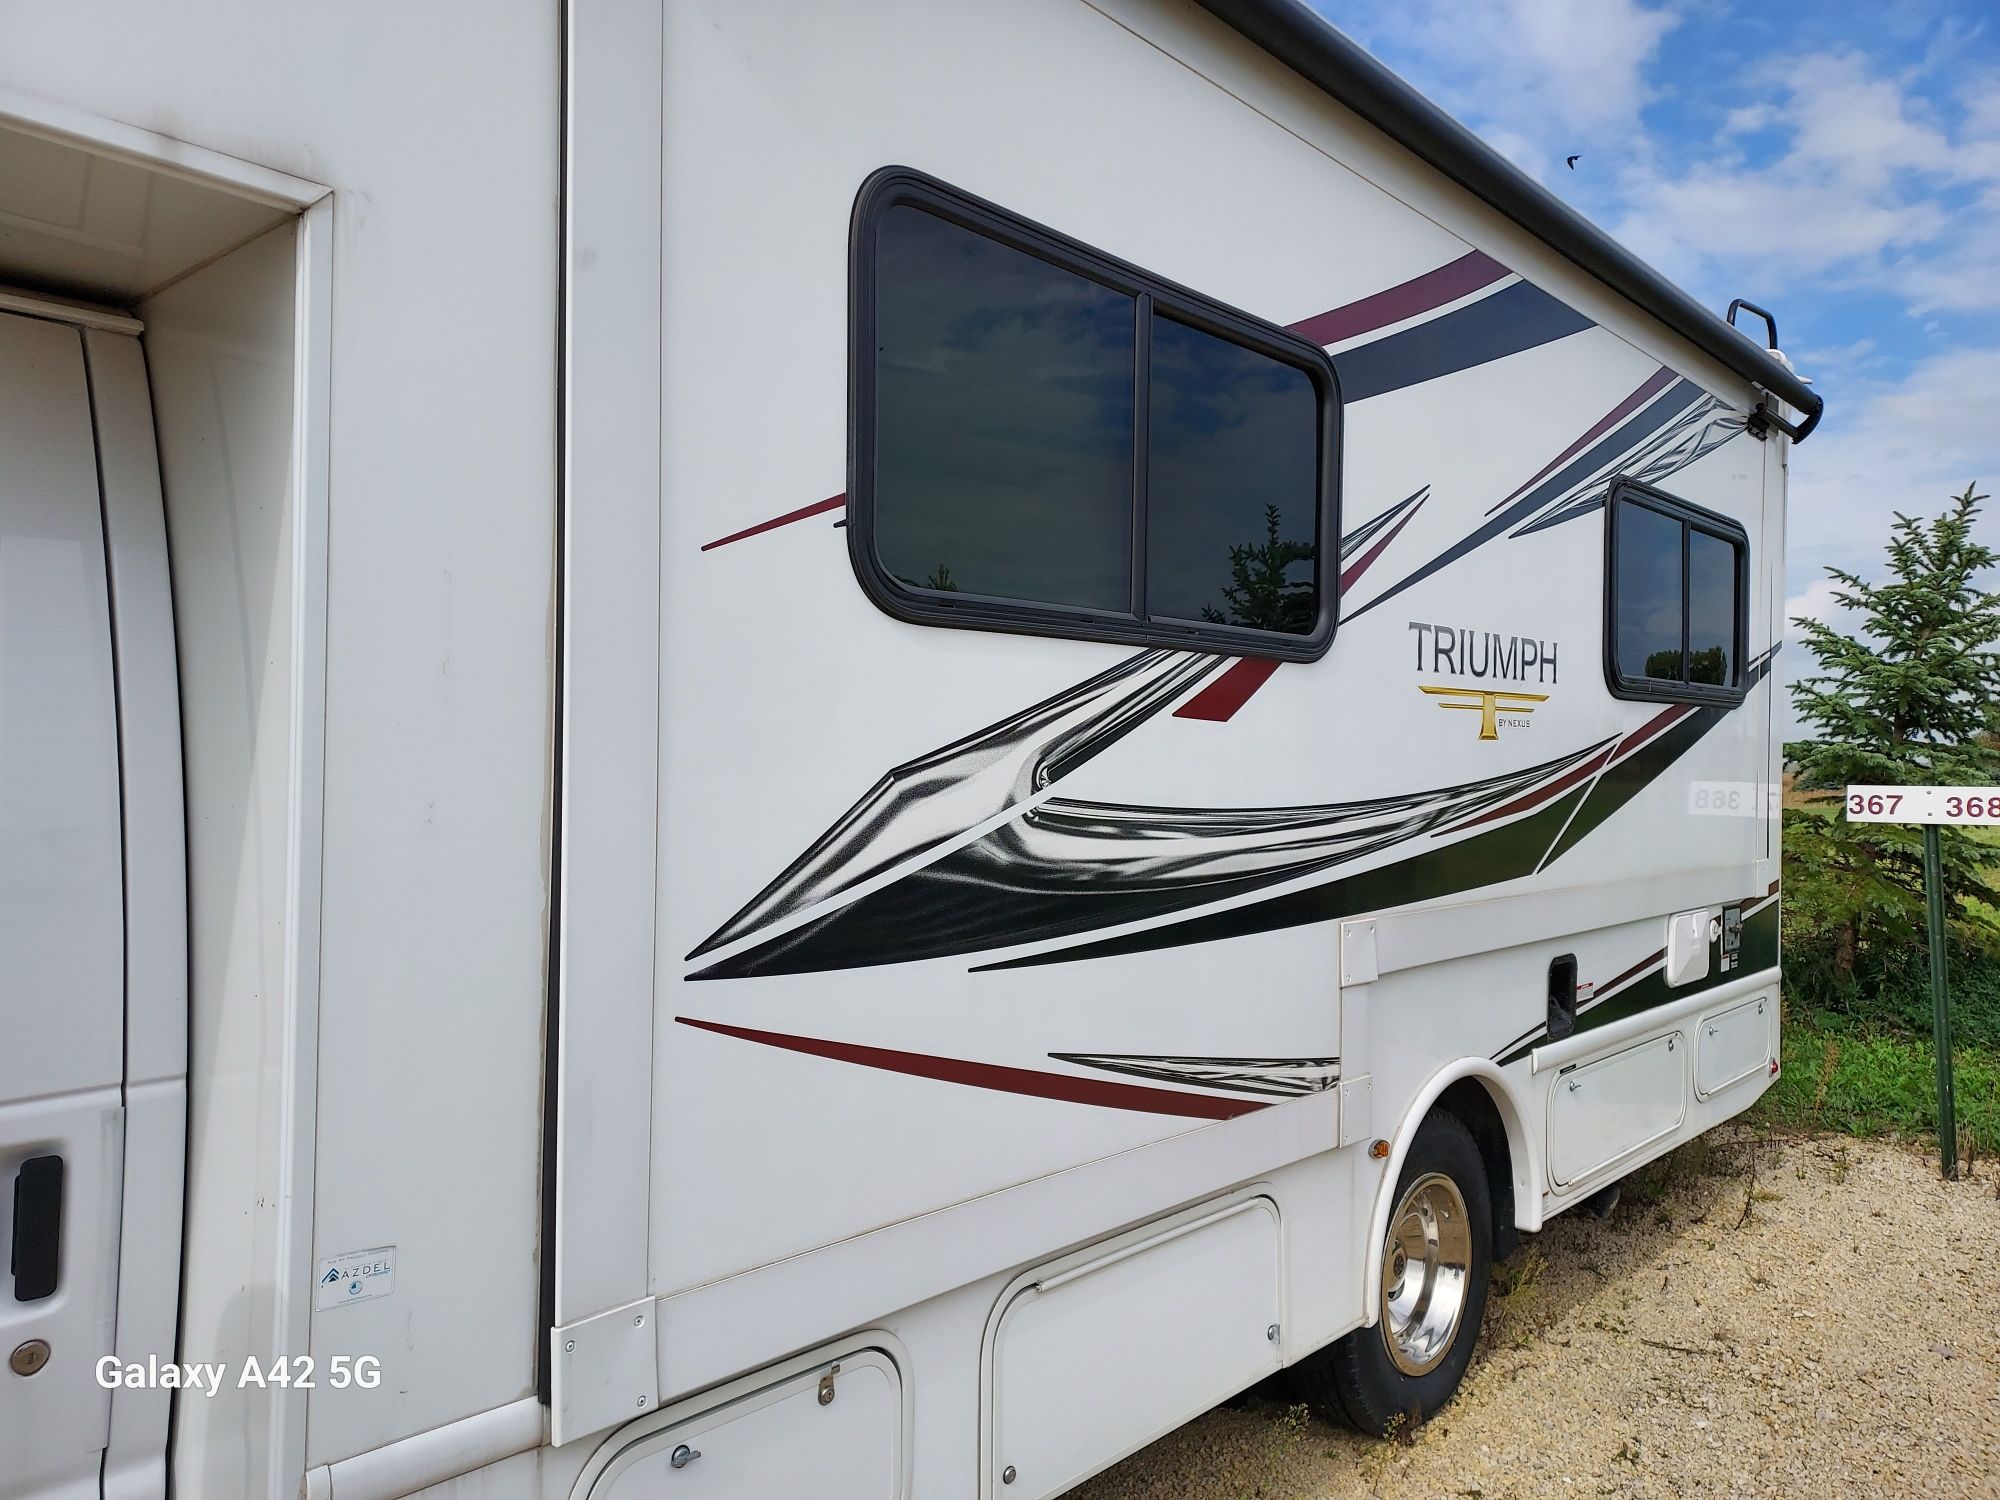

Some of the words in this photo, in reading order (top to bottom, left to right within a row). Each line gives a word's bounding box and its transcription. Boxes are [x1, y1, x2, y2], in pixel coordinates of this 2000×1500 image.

[1408, 621, 1558, 684] TRIUMPH
[1498, 718, 1506, 727] BY
[1508, 719, 1530, 728] NEXUS
[1848, 794, 1903, 815] 367
[1946, 796, 2000, 818] 368
[341, 1262, 390, 1280] AZDEL
